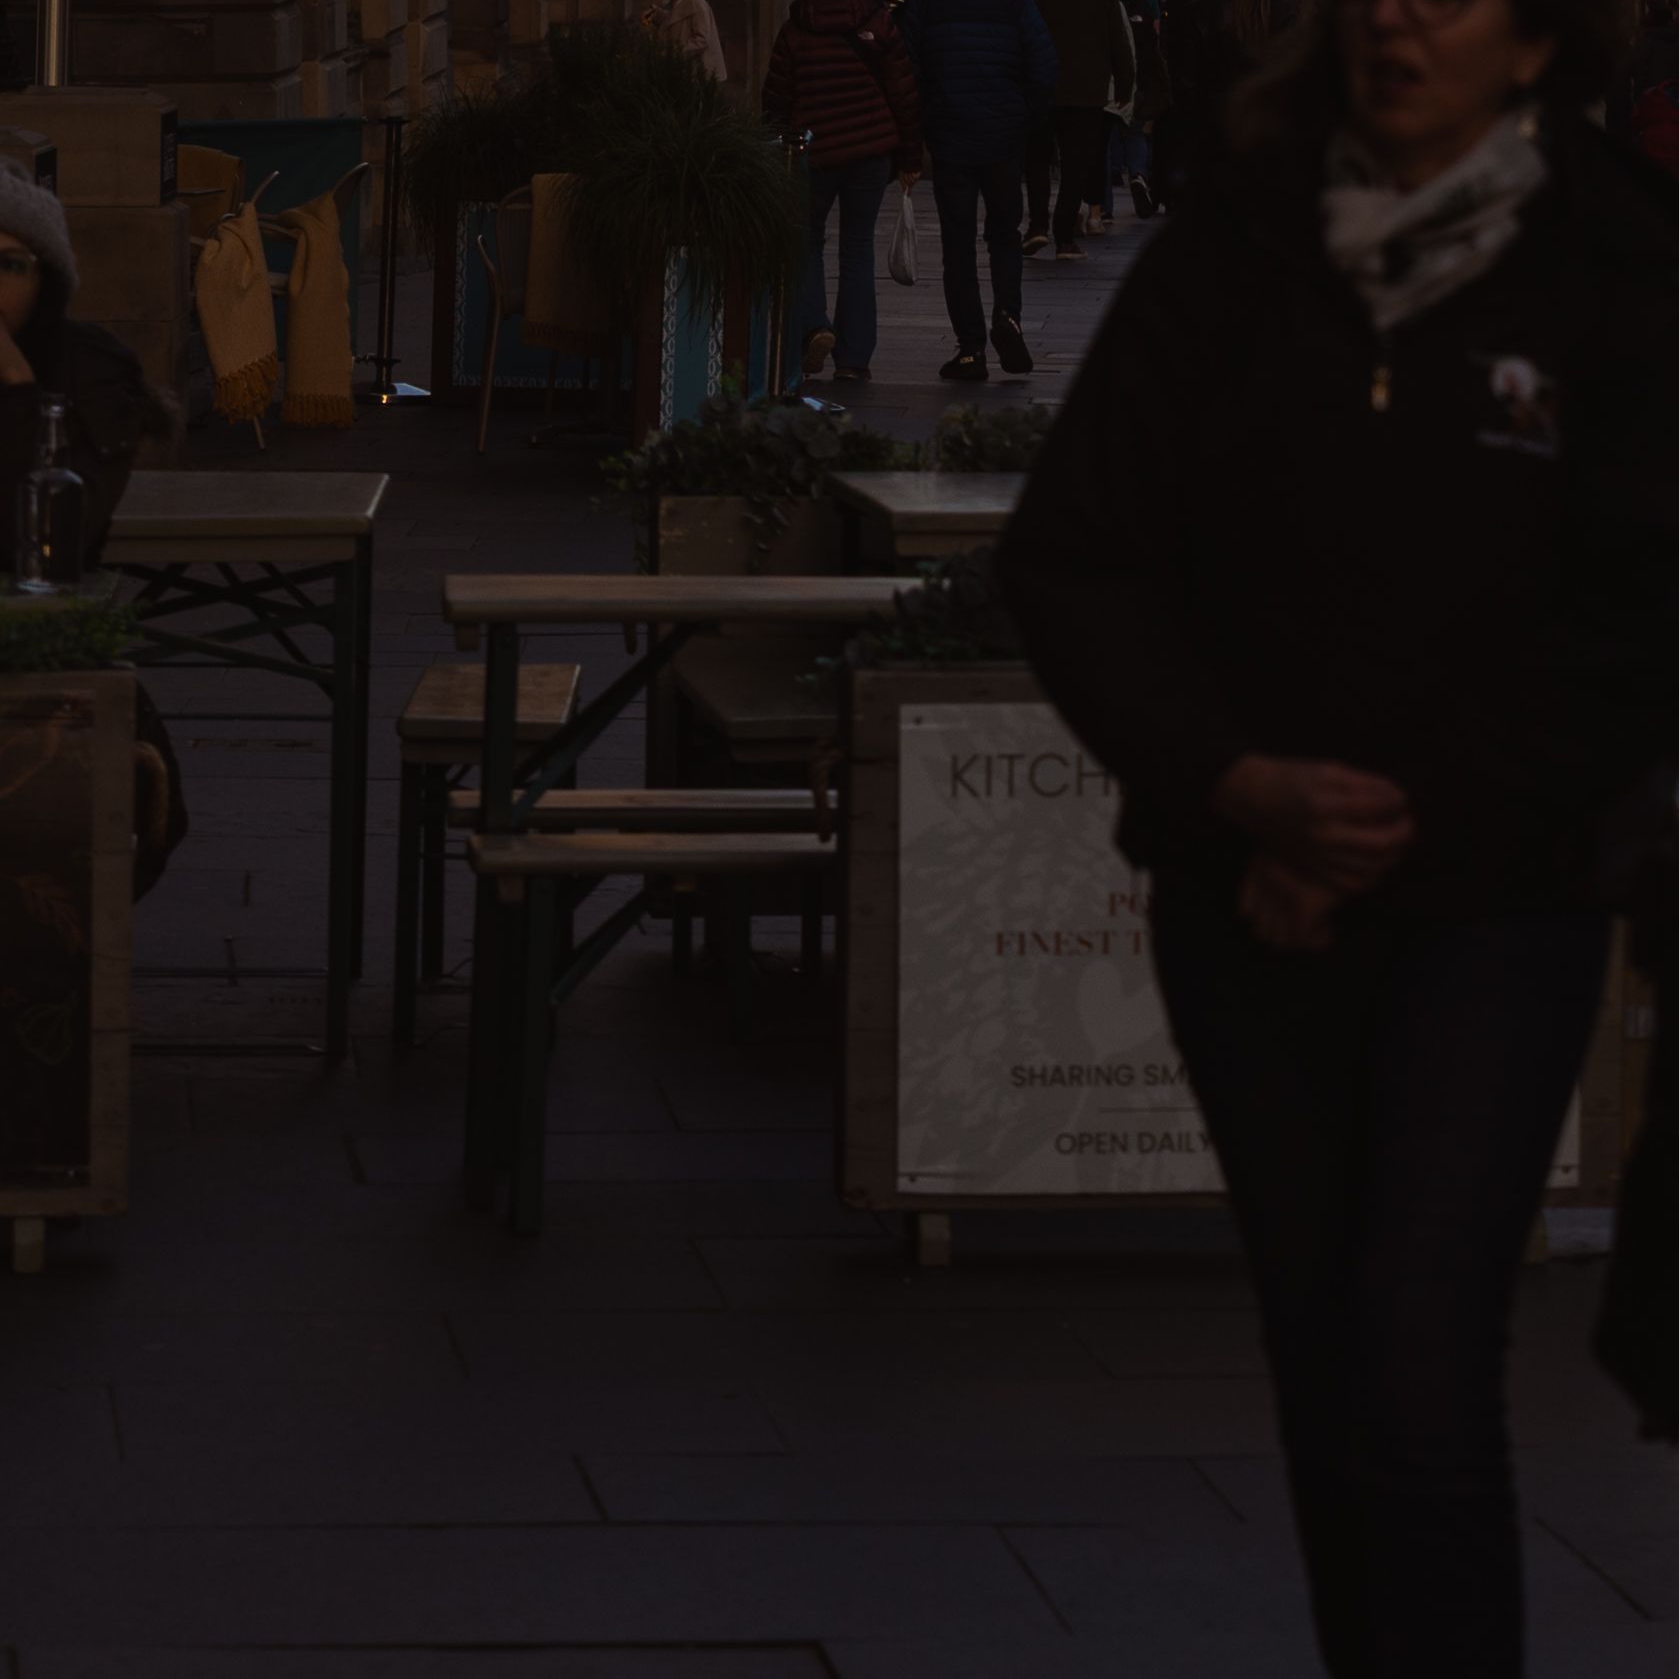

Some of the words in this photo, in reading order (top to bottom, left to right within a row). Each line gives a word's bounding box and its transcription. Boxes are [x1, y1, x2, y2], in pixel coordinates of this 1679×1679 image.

[949, 752, 1112, 800] KITCH
[995, 930, 1114, 958] FINEST
[1009, 1063, 1135, 1089] SHARING
[1053, 1131, 1129, 1156] OPEN
[1136, 1130, 1212, 1154] DAILY
